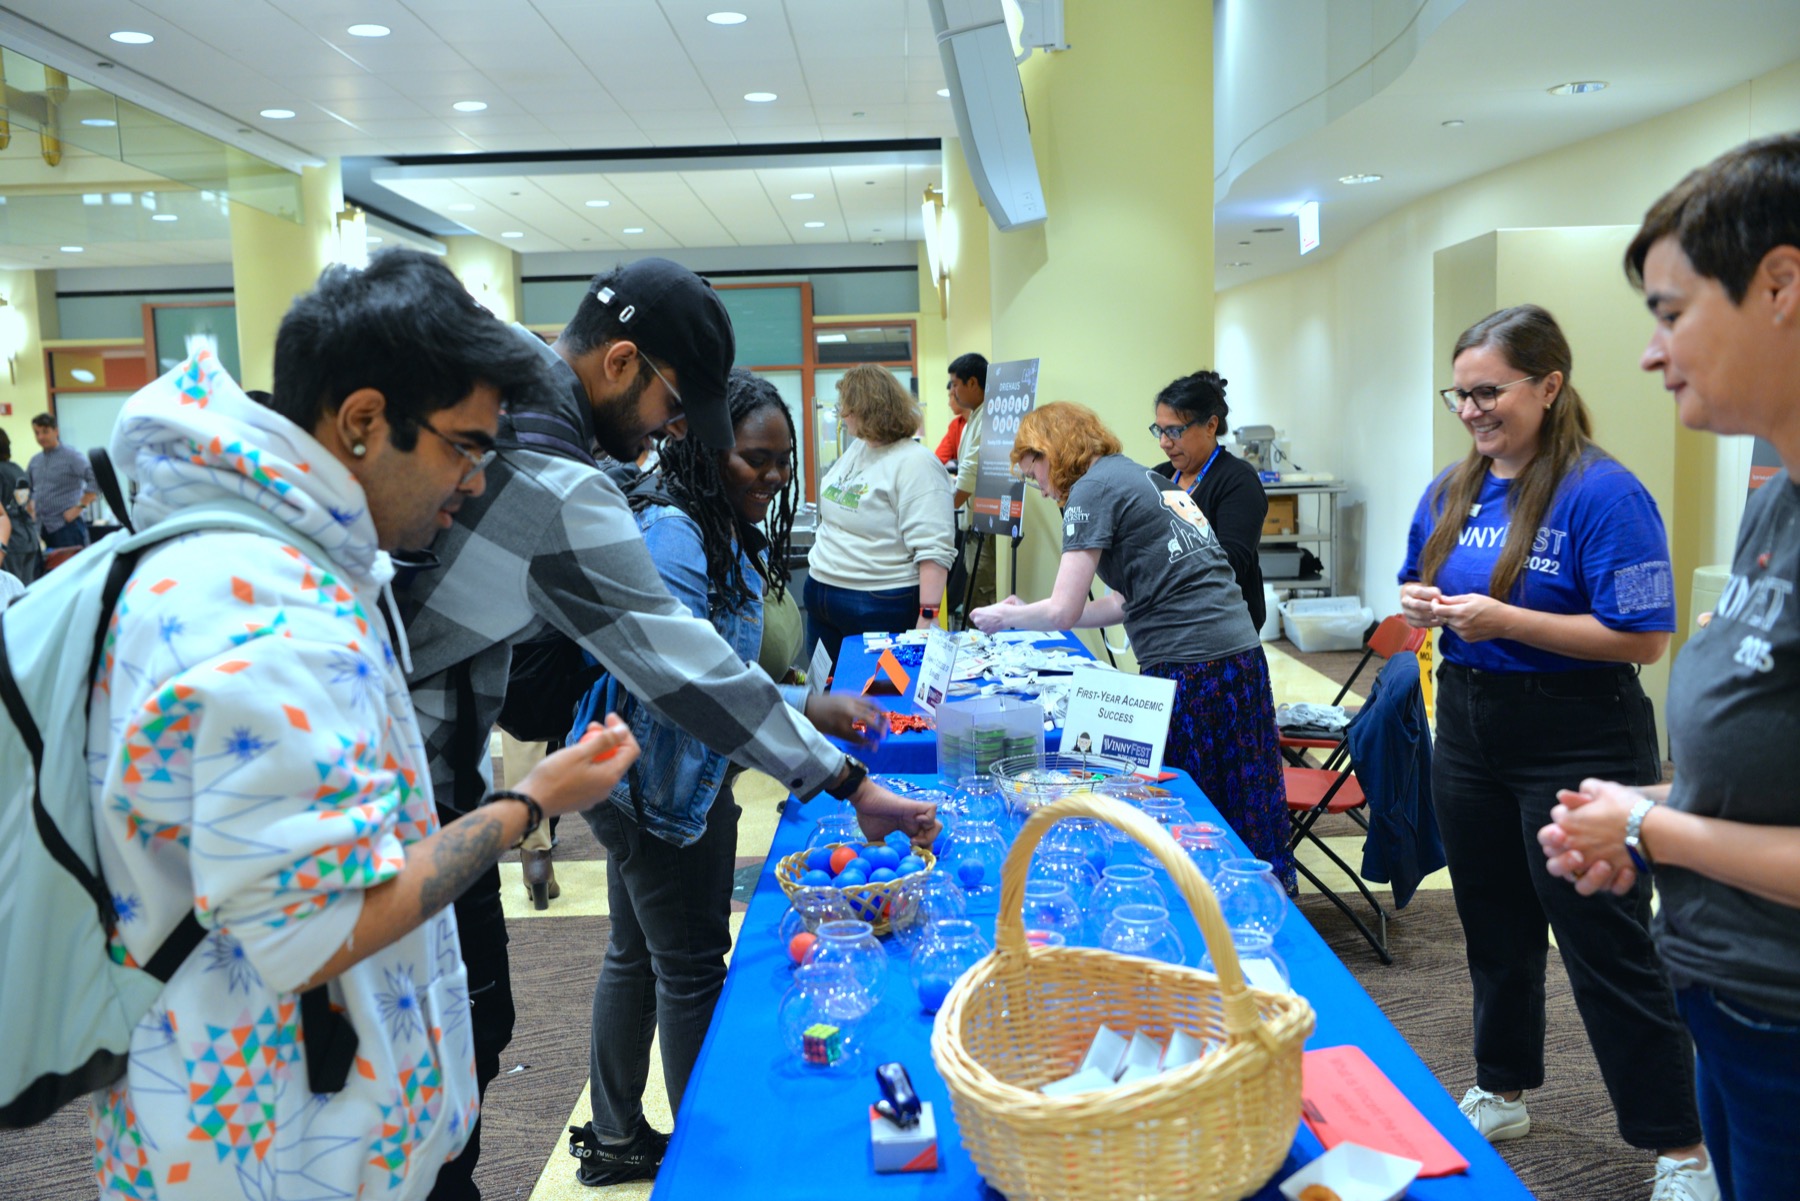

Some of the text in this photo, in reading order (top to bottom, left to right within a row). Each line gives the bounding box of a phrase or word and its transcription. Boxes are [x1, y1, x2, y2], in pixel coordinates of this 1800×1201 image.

[988, 396, 1029, 414] PUZZLE
[1076, 687, 1164, 712] FIRST-YEAR ACADEMIC
[1097, 707, 1134, 724] SUCCESS
[1104, 738, 1151, 758] VINNYFEST
